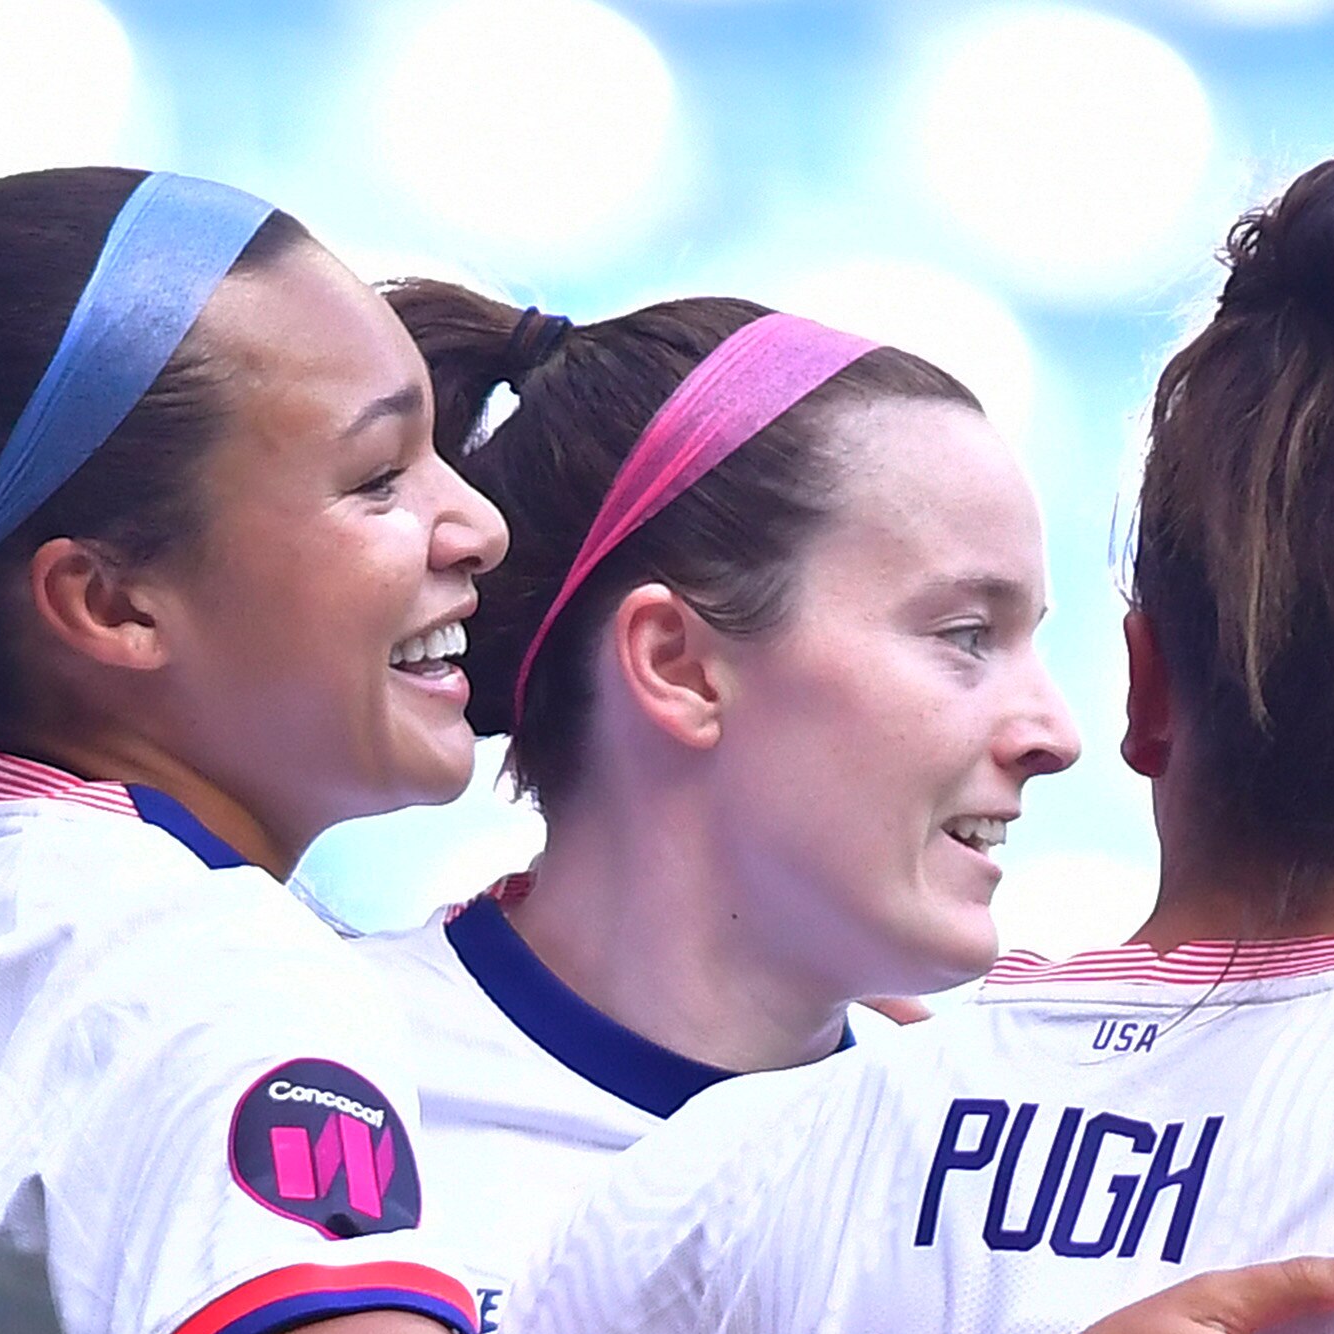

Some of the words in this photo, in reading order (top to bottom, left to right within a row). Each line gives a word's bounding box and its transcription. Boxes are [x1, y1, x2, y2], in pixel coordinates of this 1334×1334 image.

[1092, 1020, 1158, 1053] USA
[268, 1080, 385, 1129] Concacaf
[914, 1098, 1224, 1265] PUGH
